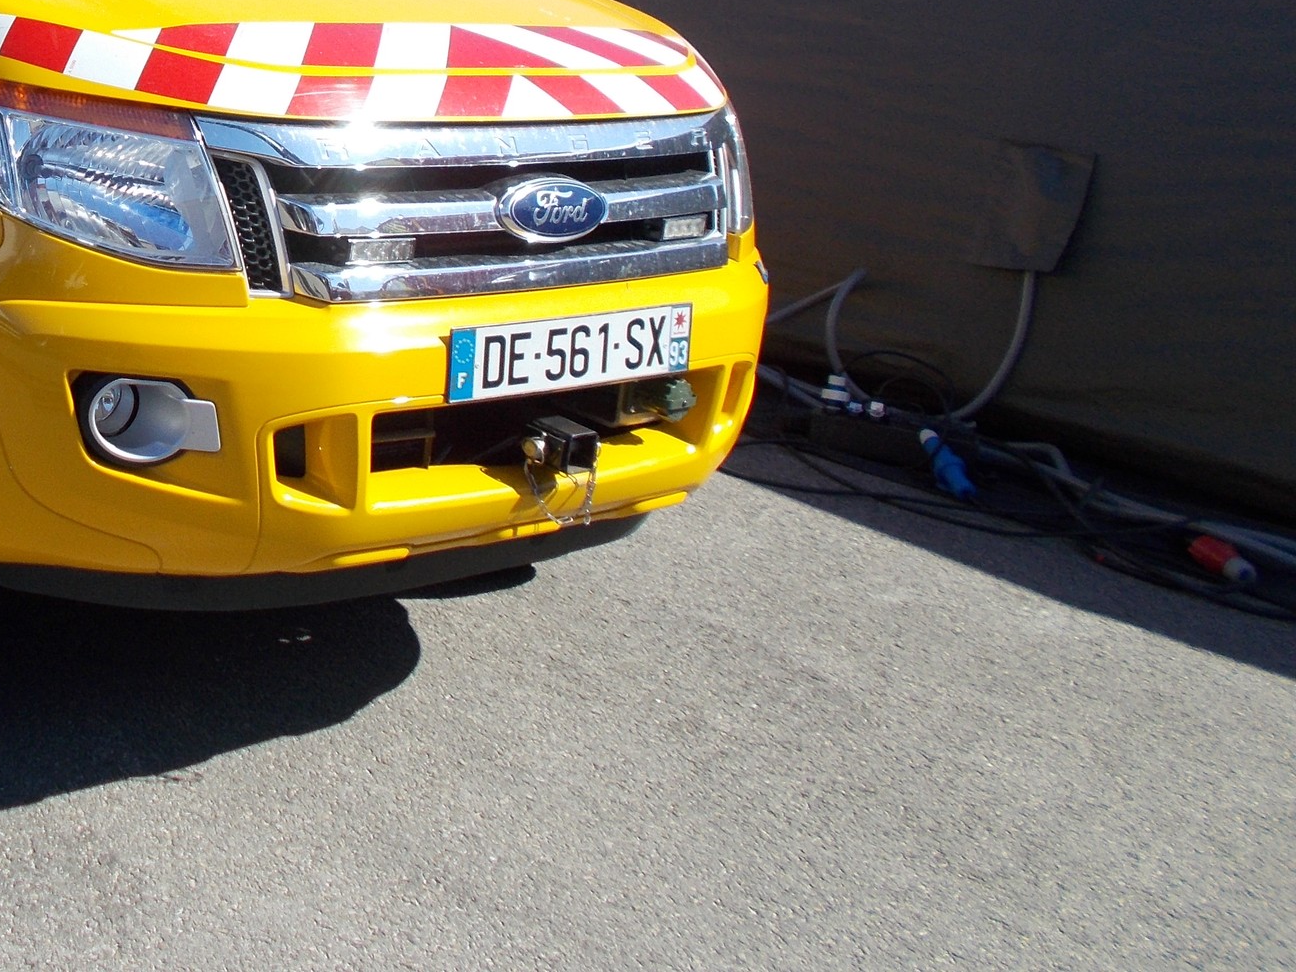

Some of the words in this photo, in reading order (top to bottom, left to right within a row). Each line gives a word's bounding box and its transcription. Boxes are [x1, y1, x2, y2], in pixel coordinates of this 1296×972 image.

[533, 188, 589, 225] Ford
[670, 340, 688, 366] 93
[457, 372, 468, 389] F
